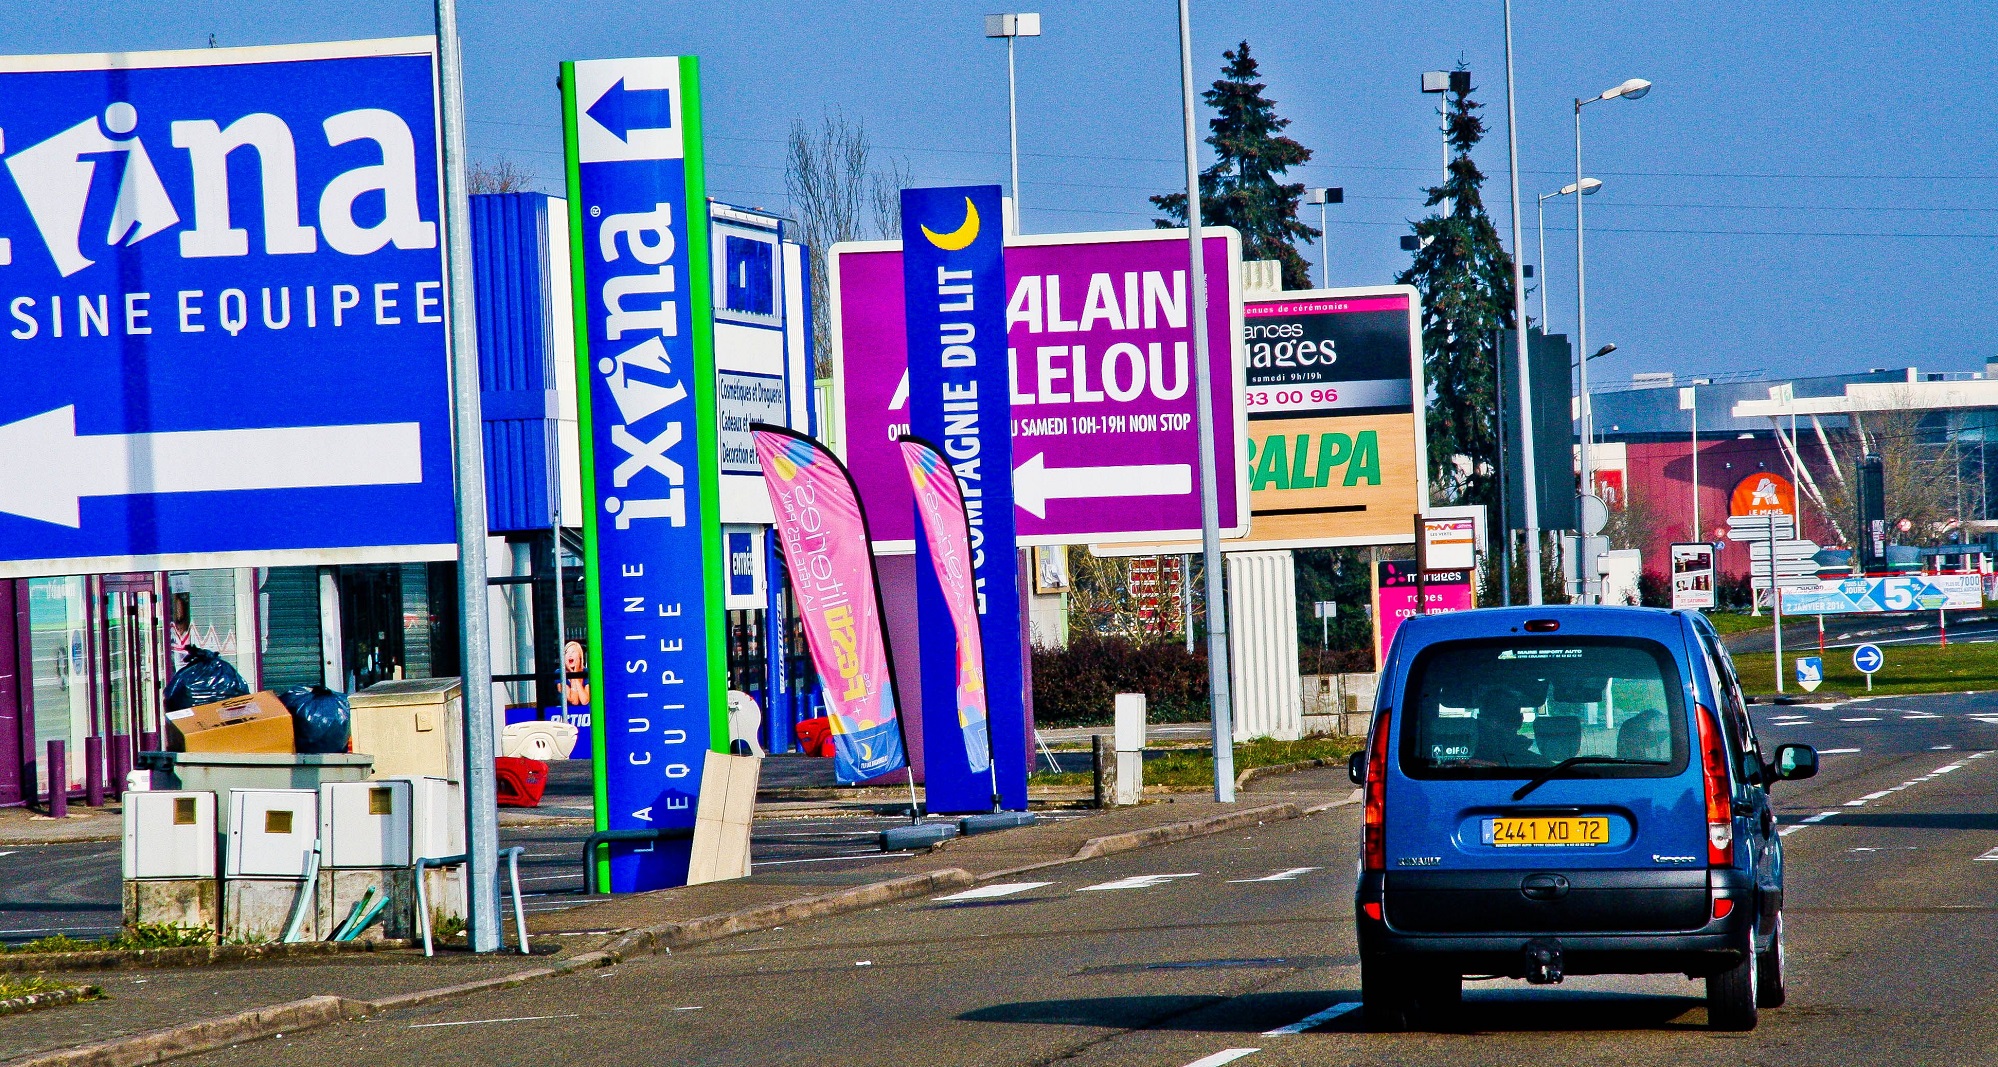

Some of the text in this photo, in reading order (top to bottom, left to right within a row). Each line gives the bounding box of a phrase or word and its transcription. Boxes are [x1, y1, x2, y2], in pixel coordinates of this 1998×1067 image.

[0, 102, 437, 278] ina
[938, 266, 974, 313] LIT
[178, 281, 443, 337] EQUIPEE
[1006, 270, 1187, 334] ALAIN
[1278, 304, 1289, 313] de
[1293, 302, 1348, 312] cérémonies
[940, 322, 976, 368] DU
[1252, 371, 1322, 383] samedi 9h/19h
[721, 378, 782, 409] Cosmétiques et Droguerie
[1275, 390, 1303, 405] 00
[1310, 388, 1338, 403] 96
[722, 410, 742, 431] Cadeaux
[1021, 417, 1068, 437] SAMEDI
[1071, 415, 1126, 435] 10H-19H
[1129, 414, 1157, 433] NON
[1160, 413, 1191, 432] STOP
[723, 441, 748, 463] Décoration
[1407, 571, 1462, 583] mriages
[1960, 576, 1980, 586] 7000
[1845, 587, 1867, 595] JOURS
[622, 563, 654, 853] LA CUISINE
[658, 602, 690, 811] EQUIPEE
[551, 713, 591, 728] ATIO
[1445, 746, 1460, 755] elf
[1494, 821, 1536, 841] 2441
[1578, 821, 1600, 840] 72
